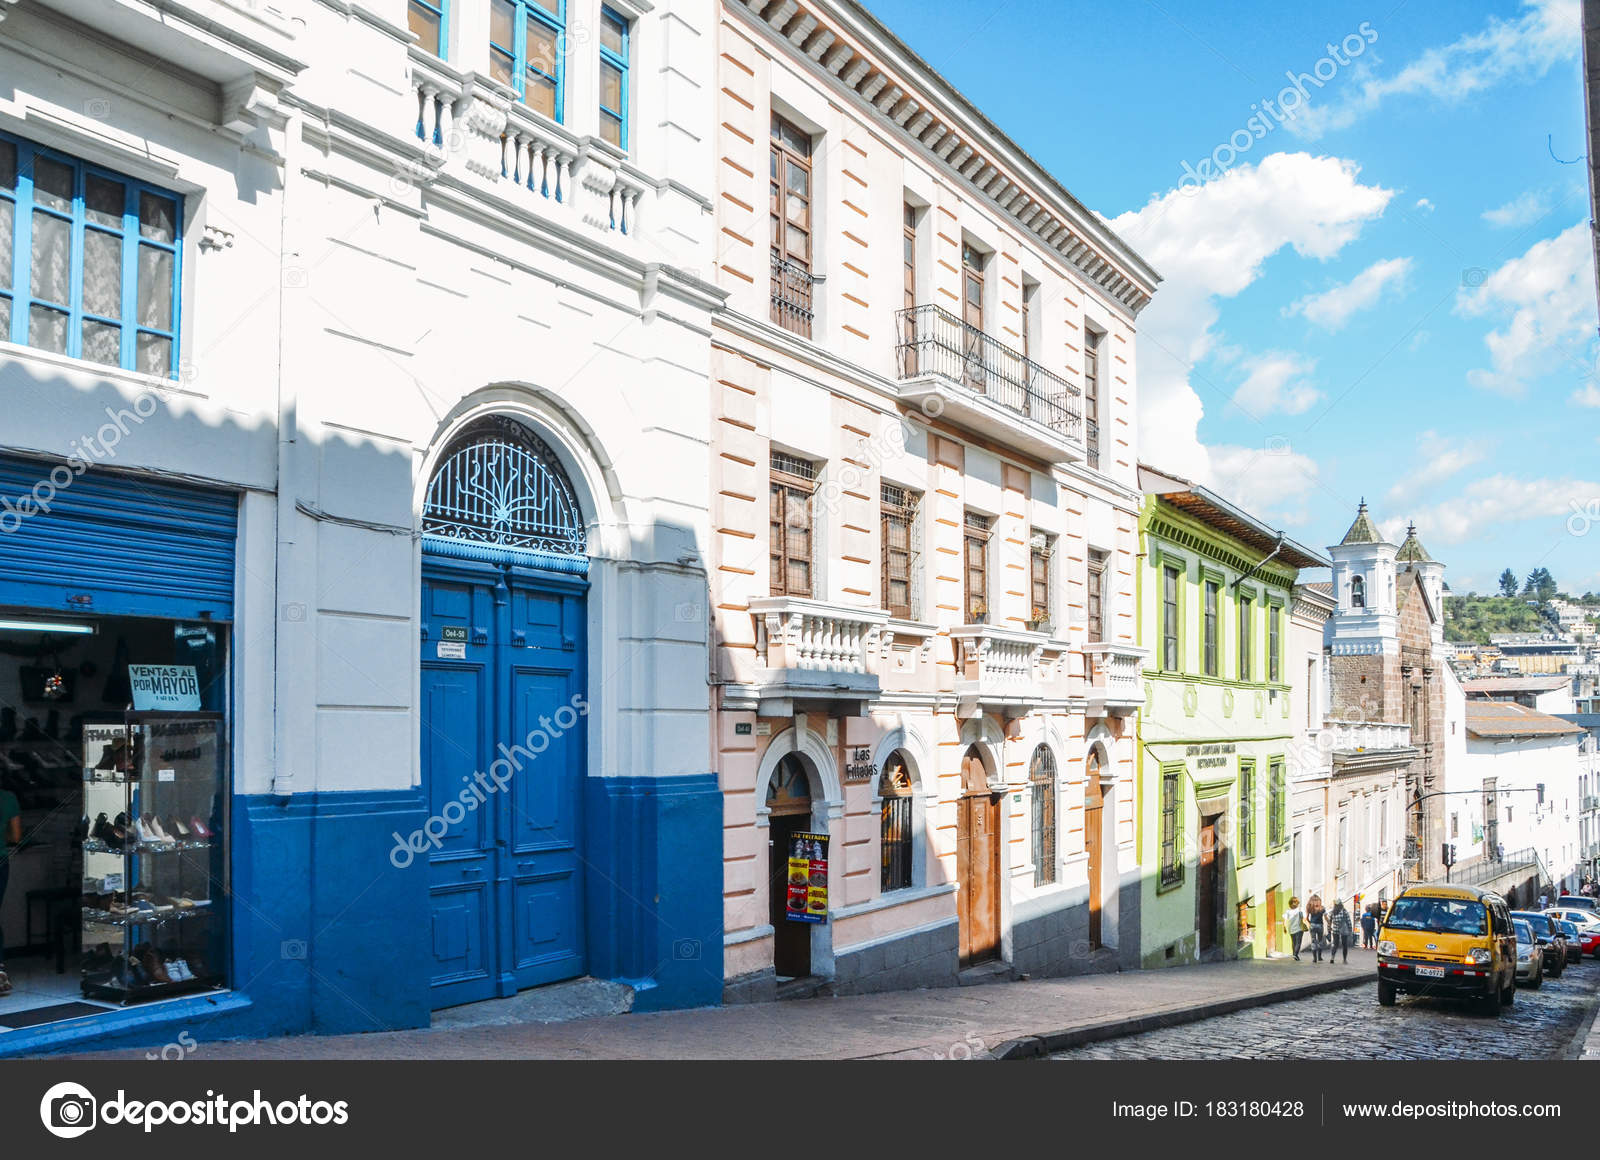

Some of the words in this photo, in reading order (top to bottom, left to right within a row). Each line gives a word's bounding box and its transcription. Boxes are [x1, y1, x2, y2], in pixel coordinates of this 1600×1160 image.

[131, 666, 178, 677] VENTAS
[181, 668, 195, 677] AL
[133, 679, 151, 691] POR
[151, 677, 198, 695] MAYOR
[854, 746, 870, 761] Las
[846, 762, 878, 779] Fritadas
